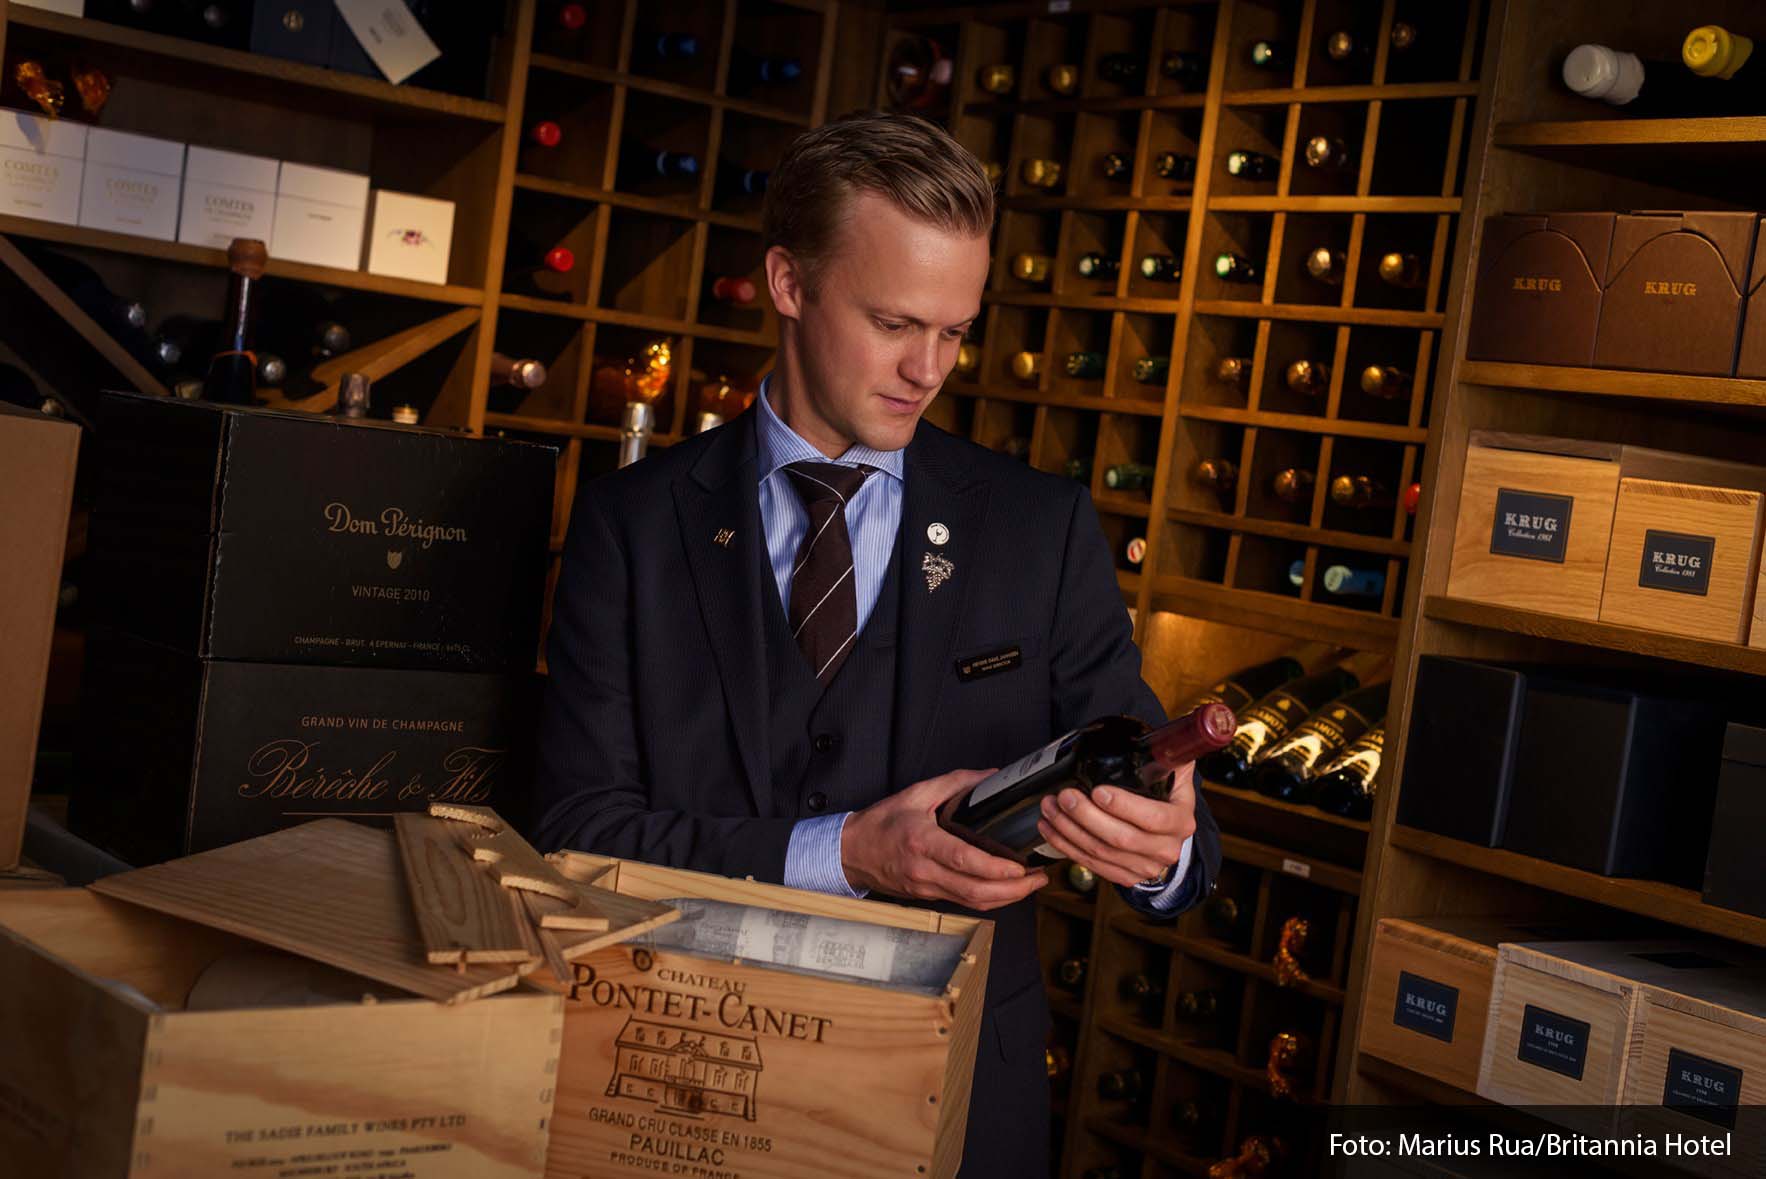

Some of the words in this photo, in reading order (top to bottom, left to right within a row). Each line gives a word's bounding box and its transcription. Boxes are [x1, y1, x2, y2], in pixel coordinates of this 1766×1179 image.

[1512, 277, 1563, 292] KRUG
[1644, 281, 1697, 296] KRUG
[324, 502, 378, 535] Dom
[381, 507, 467, 549] Pérignon
[1504, 512, 1558, 532] KRUG
[1652, 551, 1701, 569] KRUG
[352, 585, 400, 600] VINTAGE
[403, 588, 430, 602] 2010
[294, 636, 340, 647] CHAMPAGNE
[302, 716, 344, 728] GRAND
[348, 718, 368, 729] VIN
[373, 719, 388, 729] DE
[392, 719, 464, 733] CHAMPAGNE
[399, 773, 424, 801] &
[428, 747, 510, 802] Fils
[657, 967, 748, 993] CHATEAU
[567, 961, 832, 1043] PONTET-CANET
[1404, 992, 1448, 1018] KRUG
[1534, 1023, 1575, 1046] KRUG
[1680, 1069, 1725, 1094] KRUG
[225, 1130, 255, 1144] THE
[306, 1123, 358, 1138] FAMILY
[364, 1119, 408, 1133] WINES
[412, 1116, 437, 1130] PTY
[439, 1114, 466, 1128] LTD
[589, 1107, 635, 1128] GRAND
[638, 1114, 666, 1134] CRU
[668, 1121, 719, 1145] CLASSE
[722, 1128, 739, 1146] EN
[744, 1132, 772, 1152] 1855
[630, 1133, 724, 1166] PAUILLAC
[609, 1151, 668, 1173] PRODUCE
[672, 1160, 688, 1175] OF
